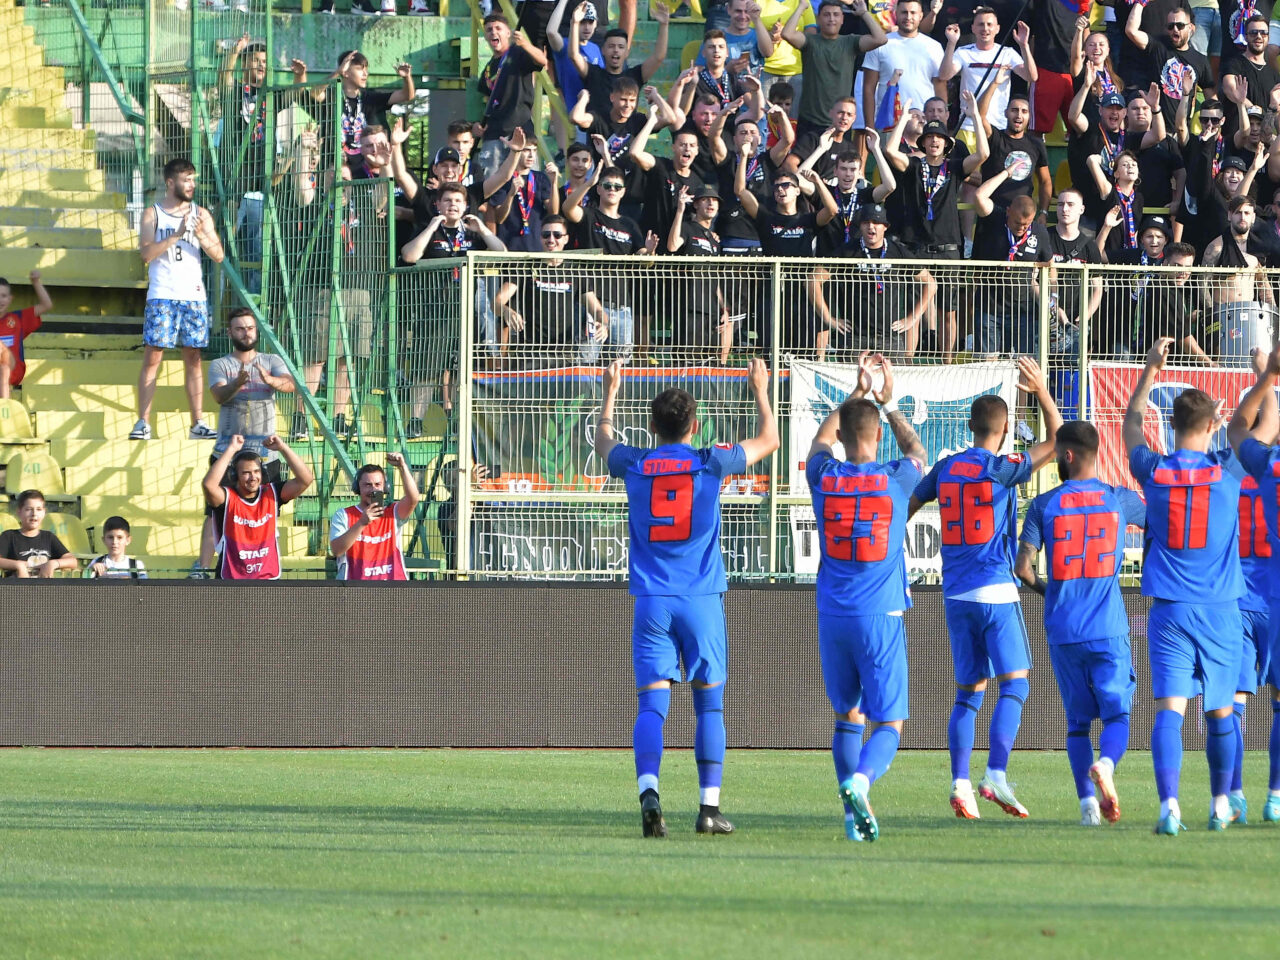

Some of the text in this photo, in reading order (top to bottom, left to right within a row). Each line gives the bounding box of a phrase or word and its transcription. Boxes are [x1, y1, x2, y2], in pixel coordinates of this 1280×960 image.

[650, 474, 694, 542] 9
[823, 496, 893, 562] 23
[939, 481, 995, 545] 26
[1167, 485, 1210, 550] 11
[239, 547, 269, 560] STAFF
[364, 564, 392, 577] STAFF
[1052, 512, 1119, 580] 22
